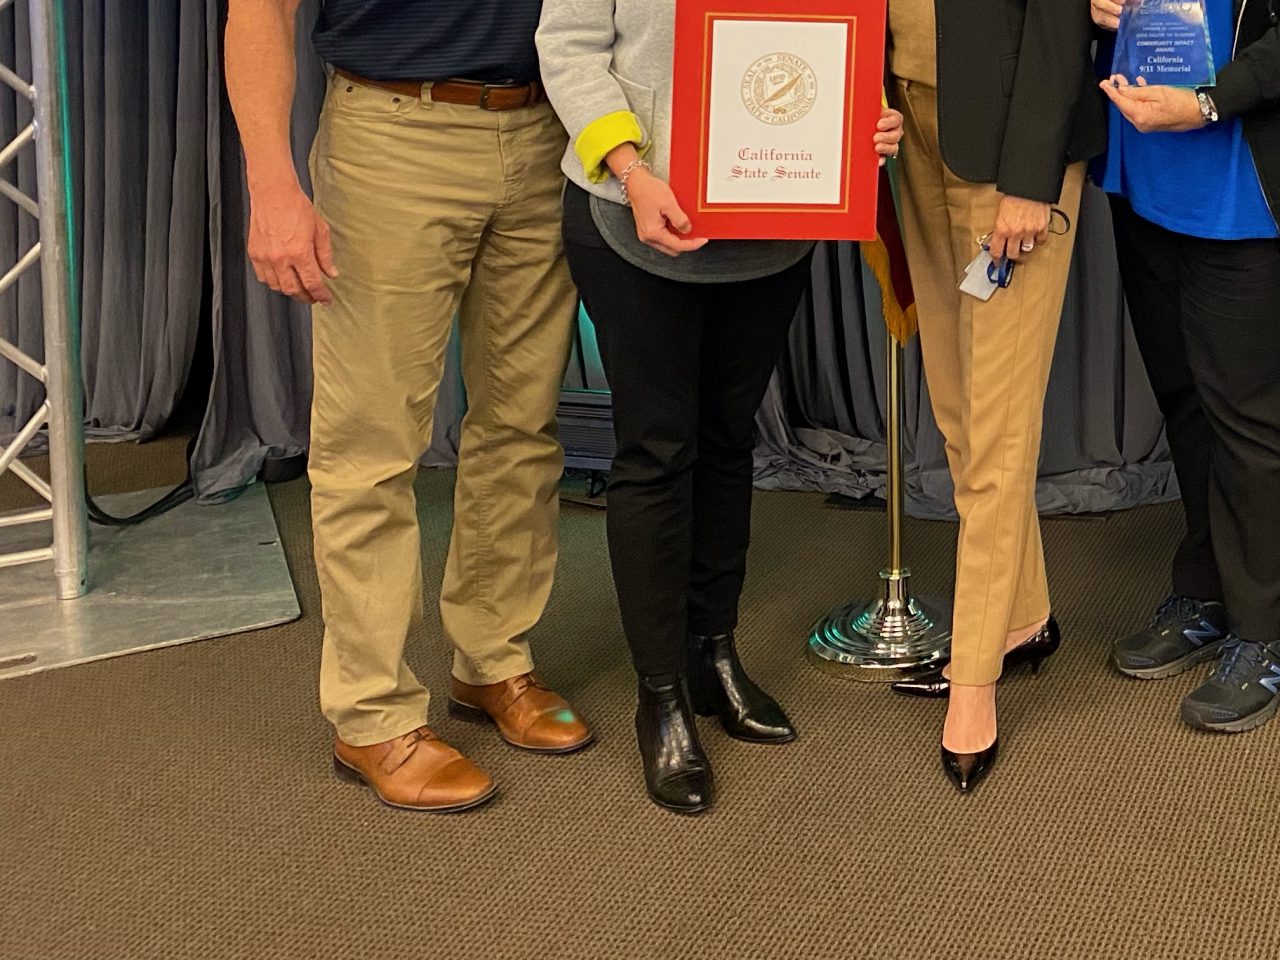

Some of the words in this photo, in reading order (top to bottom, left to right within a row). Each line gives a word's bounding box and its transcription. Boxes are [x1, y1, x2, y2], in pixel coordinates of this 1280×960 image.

[1147, 56, 1184, 64] California
[1139, 64, 1154, 73] 9/11
[1156, 64, 1191, 73] Memorial
[738, 147, 813, 161] California
[727, 165, 769, 182] State
[770, 165, 822, 182] Senate
